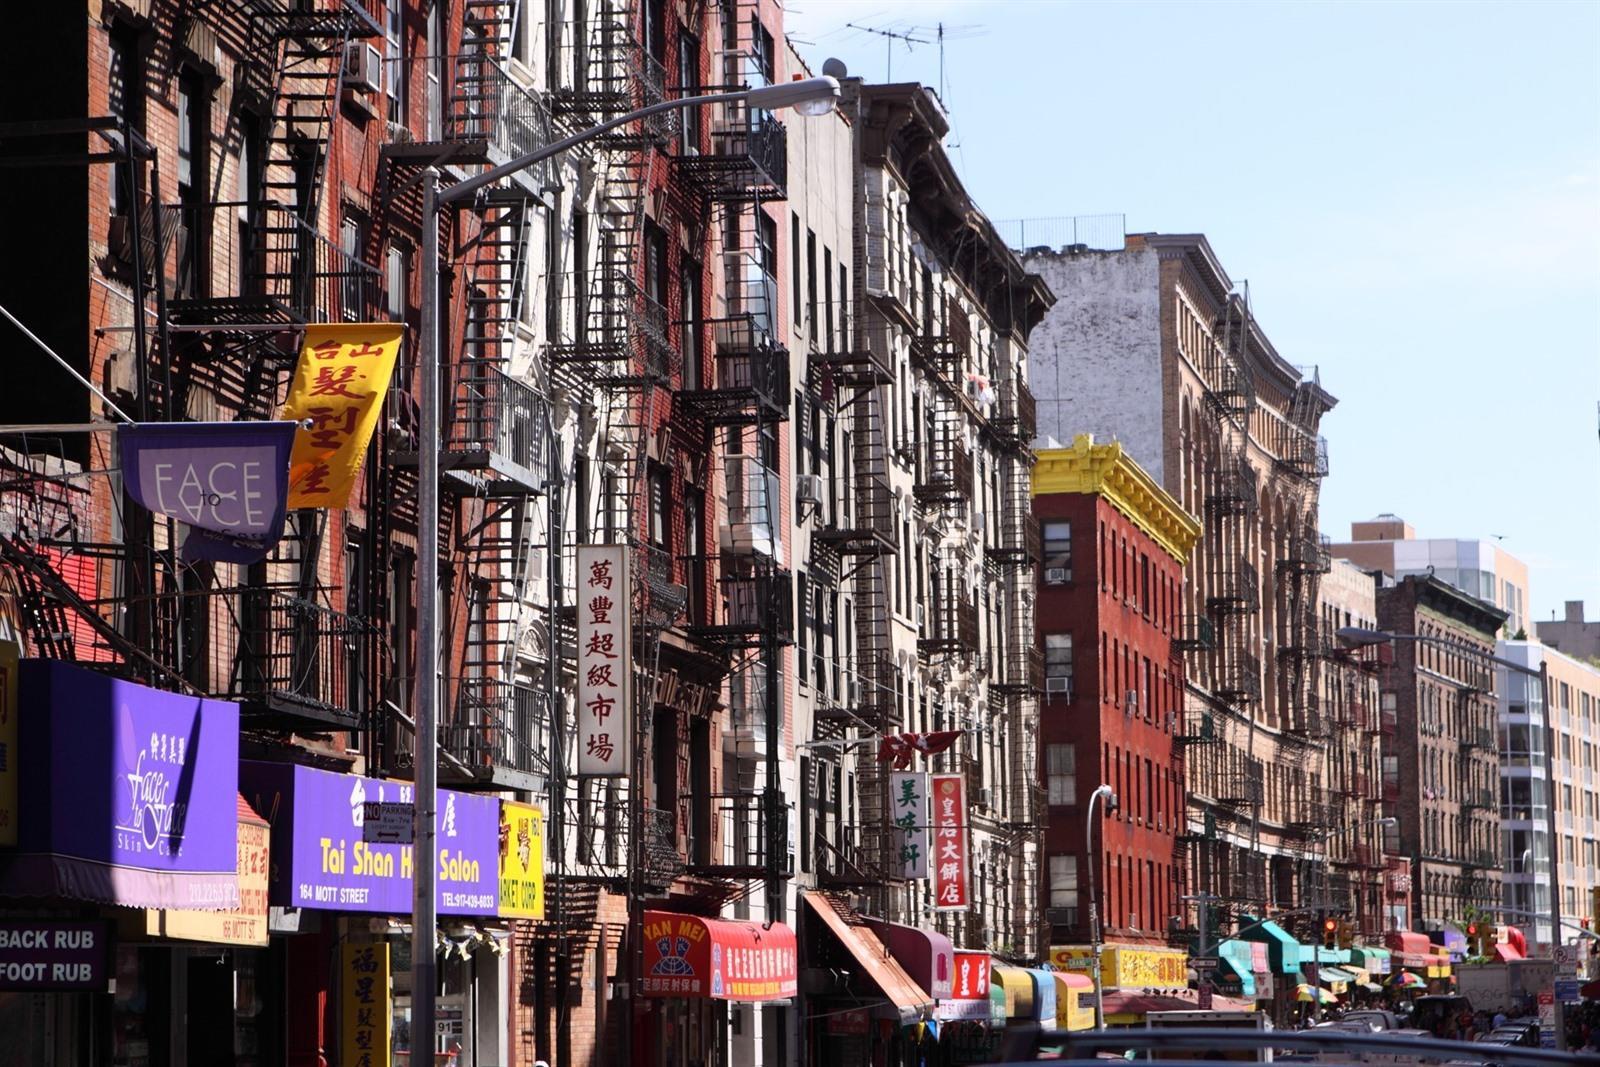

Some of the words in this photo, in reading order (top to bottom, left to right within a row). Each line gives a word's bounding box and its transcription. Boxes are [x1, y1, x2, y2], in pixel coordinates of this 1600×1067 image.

[312, 339, 384, 361] 台山
[154, 461, 261, 503] FACE
[585, 559, 619, 763] 萬豐超級市場
[365, 806, 380, 819] NO
[118, 832, 142, 853] Skin
[938, 798, 961, 903] 皇后大餅店
[320, 837, 346, 875] Tai
[353, 841, 393, 878] Shan
[440, 849, 479, 883] Salon
[299, 884, 313, 899] 164
[315, 885, 337, 902] MOTT
[340, 887, 369, 904] STREET
[0, 931, 49, 949] BACK
[55, 931, 94, 948] RUB
[232, 921, 247, 938] MOTT
[644, 920, 672, 940] YAN
[678, 921, 707, 942] MEI
[0, 963, 47, 982] FOOT
[53, 964, 92, 982] RUB
